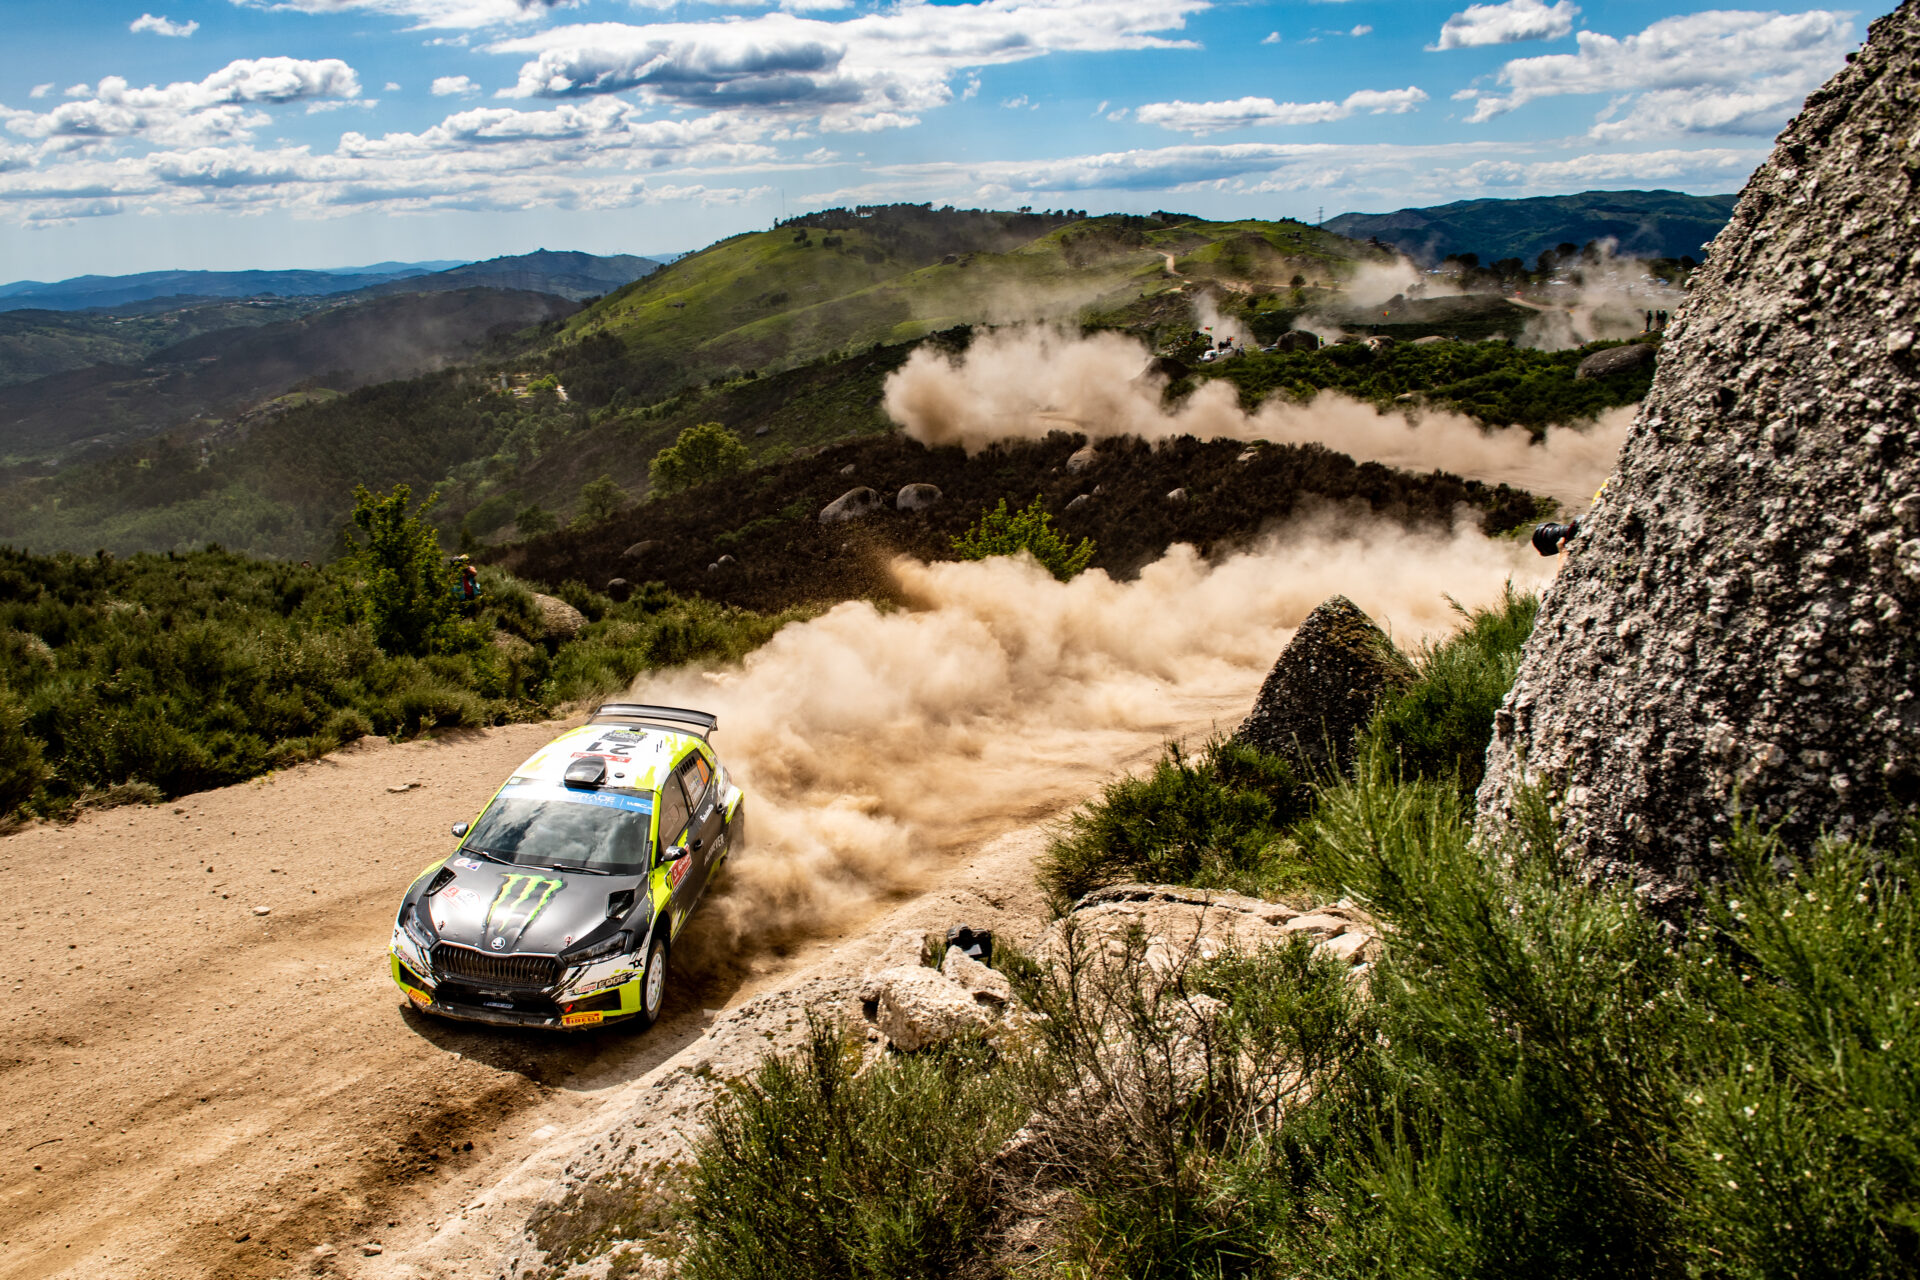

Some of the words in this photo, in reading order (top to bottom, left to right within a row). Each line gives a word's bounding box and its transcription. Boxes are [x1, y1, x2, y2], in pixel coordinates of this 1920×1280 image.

[586, 742, 637, 755] 21
[599, 974, 627, 989] EDGE
[565, 1013, 600, 1025] PIRELLI
